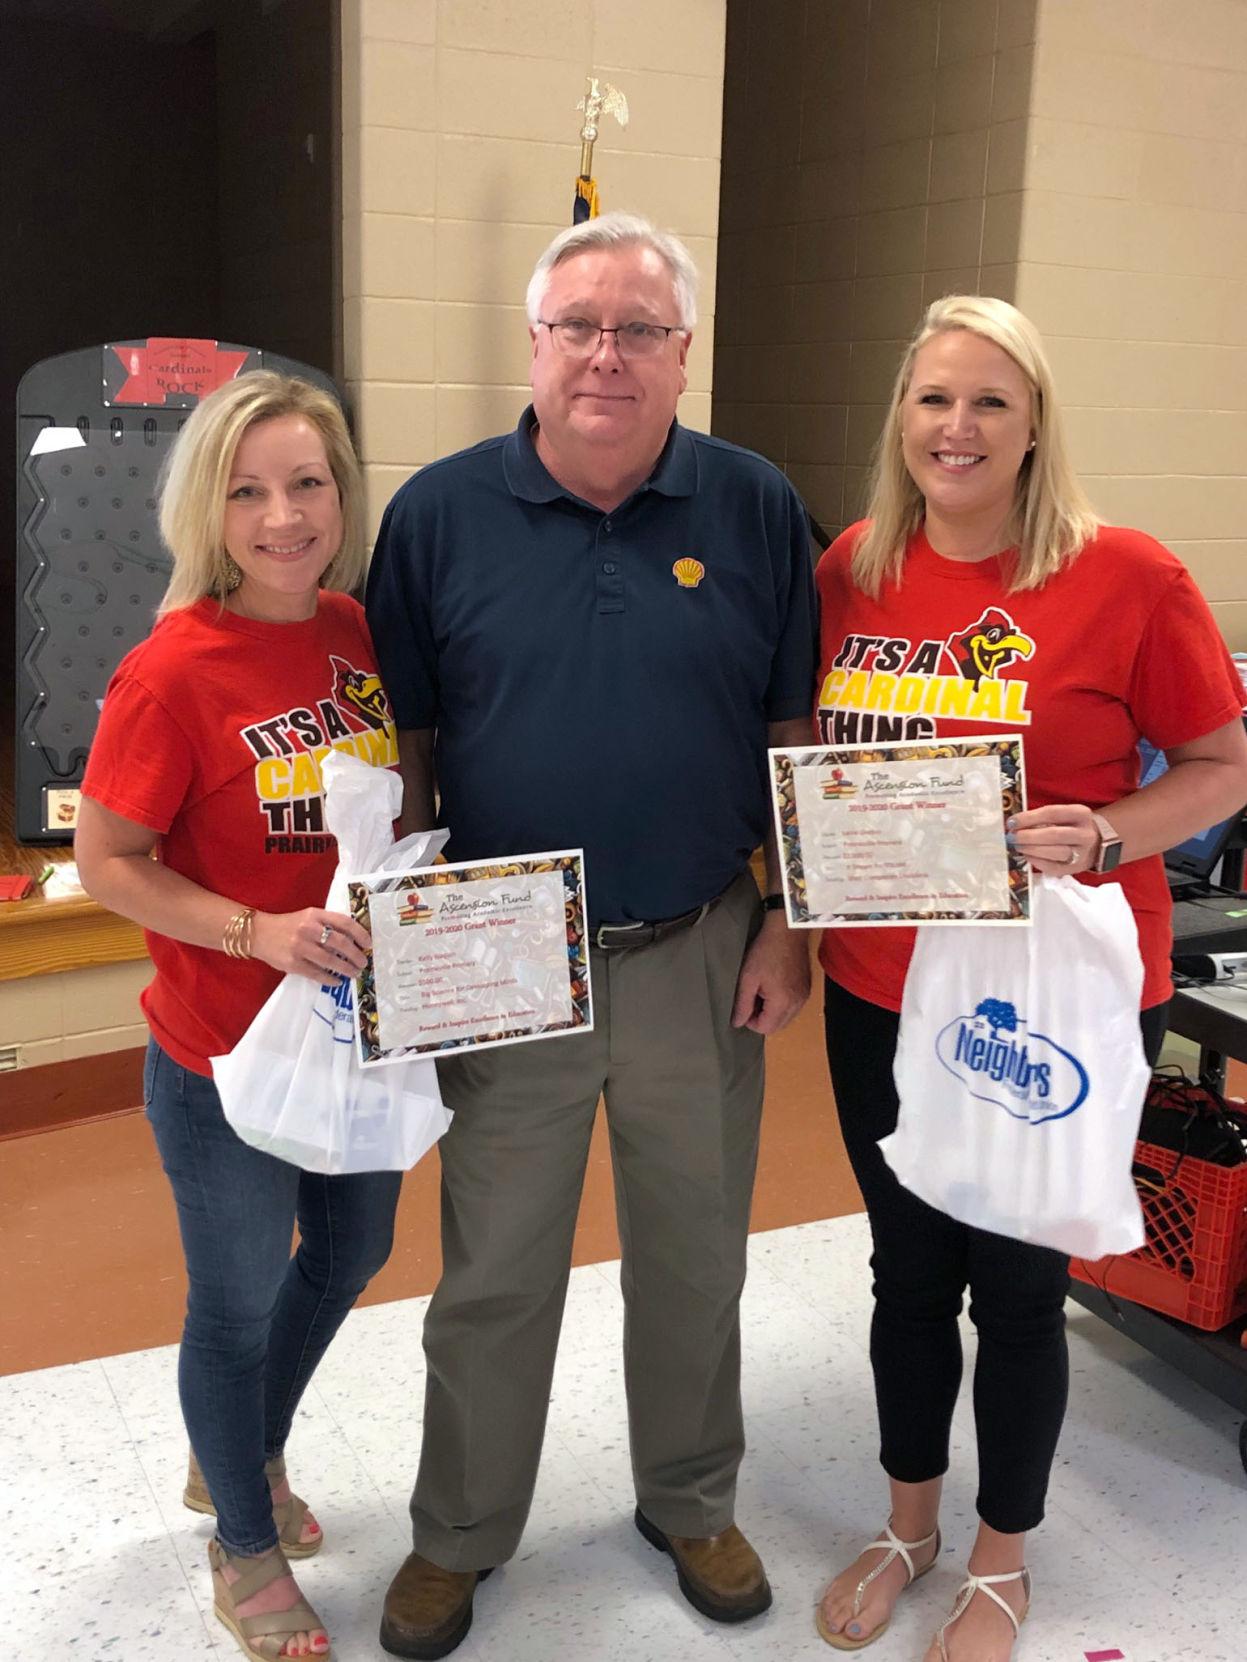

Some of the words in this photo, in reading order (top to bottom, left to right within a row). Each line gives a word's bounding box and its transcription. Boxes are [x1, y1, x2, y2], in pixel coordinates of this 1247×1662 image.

[156, 377, 205, 394] ROCK
[833, 634, 909, 672] IT'S
[902, 640, 944, 676] A
[818, 667, 1031, 725] CARDINAL
[240, 707, 325, 760] IT'S
[317, 699, 353, 743] A
[863, 780, 927, 793] Ascension
[929, 774, 964, 788] Fund
[870, 772, 890, 781] The
[890, 802, 914, 811] Grant
[916, 801, 946, 810] Winner
[439, 899, 498, 914] Ascension
[500, 890, 532, 906] Fund
[446, 893, 464, 903] The
[425, 924, 463, 937] 2019-2020
[464, 921, 487, 932] Grant
[488, 916, 516, 927] Winner
[954, 1022, 1052, 1098] Neighbrs
